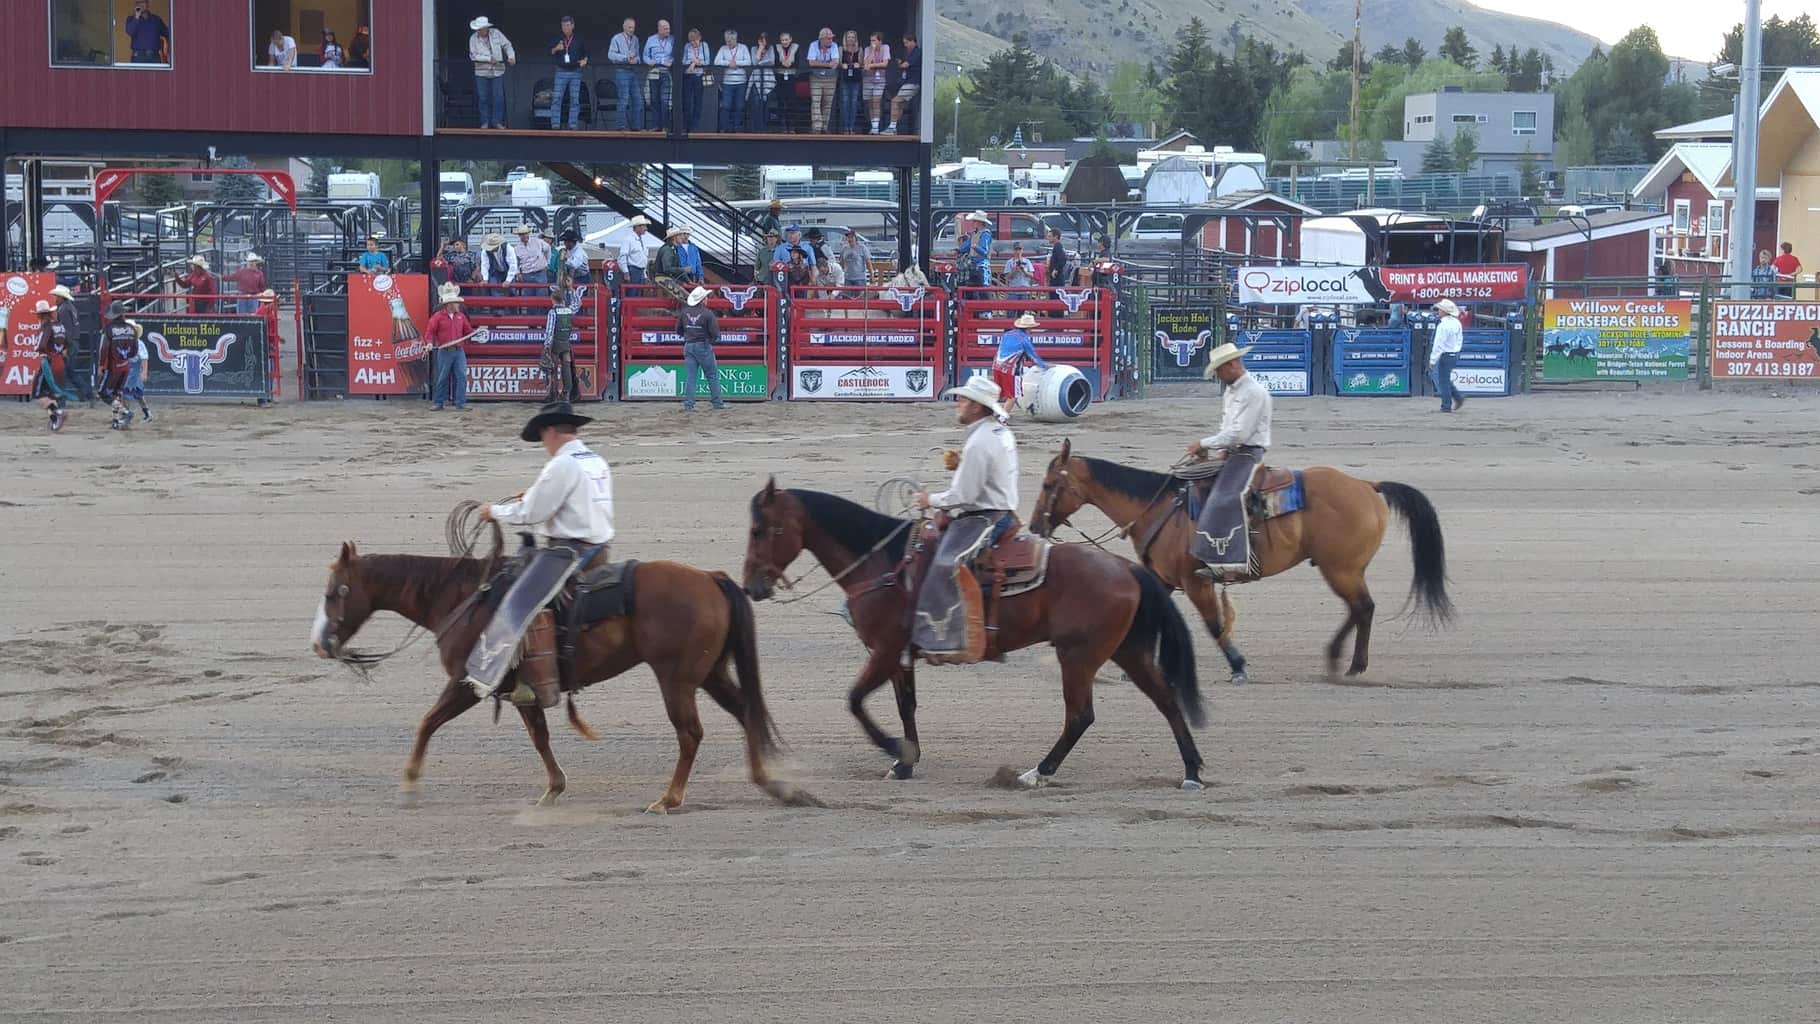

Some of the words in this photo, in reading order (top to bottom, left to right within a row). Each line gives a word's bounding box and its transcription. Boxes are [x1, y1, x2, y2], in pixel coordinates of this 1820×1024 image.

[607, 270, 614, 280] 5
[777, 271, 784, 281] 6
[945, 273, 952, 283] 7
[1112, 273, 1119, 283] 8
[1389, 273, 1416, 285] PRINT
[1417, 272, 1426, 285] &
[1427, 271, 1462, 284] DIGITAL
[1463, 271, 1518, 283] MARKETING
[1272, 276, 1348, 296] ziplocal
[1569, 302, 1621, 313] Willow
[1625, 302, 1665, 313] Creek
[1557, 315, 1637, 327] HORSEBACK
[1641, 315, 1679, 327] RIDES
[163, 323, 198, 336] Jackson
[200, 323, 221, 335] Hole
[1172, 323, 1198, 333] Rodeo
[1716, 321, 1776, 336] RANCH
[180, 336, 208, 347] Rodeo
[354, 336, 373, 347] fizz
[491, 332, 526, 341] JACKSON
[527, 332, 547, 341] HOL
[720, 334, 748, 342] RODEO
[830, 334, 864, 343] JACKSON
[866, 334, 887, 343] HOLE
[888, 335, 915, 343] RODEO
[1032, 335, 1054, 344] HOLE
[1055, 336, 1082, 344] RODEO
[1716, 340, 1753, 348] Lessons
[1755, 340, 1762, 348] &
[1764, 339, 1805, 351] Boarding
[354, 351, 381, 360] taste
[1715, 350, 1745, 359] Indoor
[1746, 350, 1774, 359] Arena
[1727, 362, 1815, 376] 307.413.9187
[354, 368, 396, 384] AHH
[738, 371, 753, 381] OF
[1458, 374, 1504, 384] ziplocal
[466, 380, 519, 393] ANCH
[733, 382, 766, 393] HOLE
[837, 378, 890, 387] CASTLEROCK
